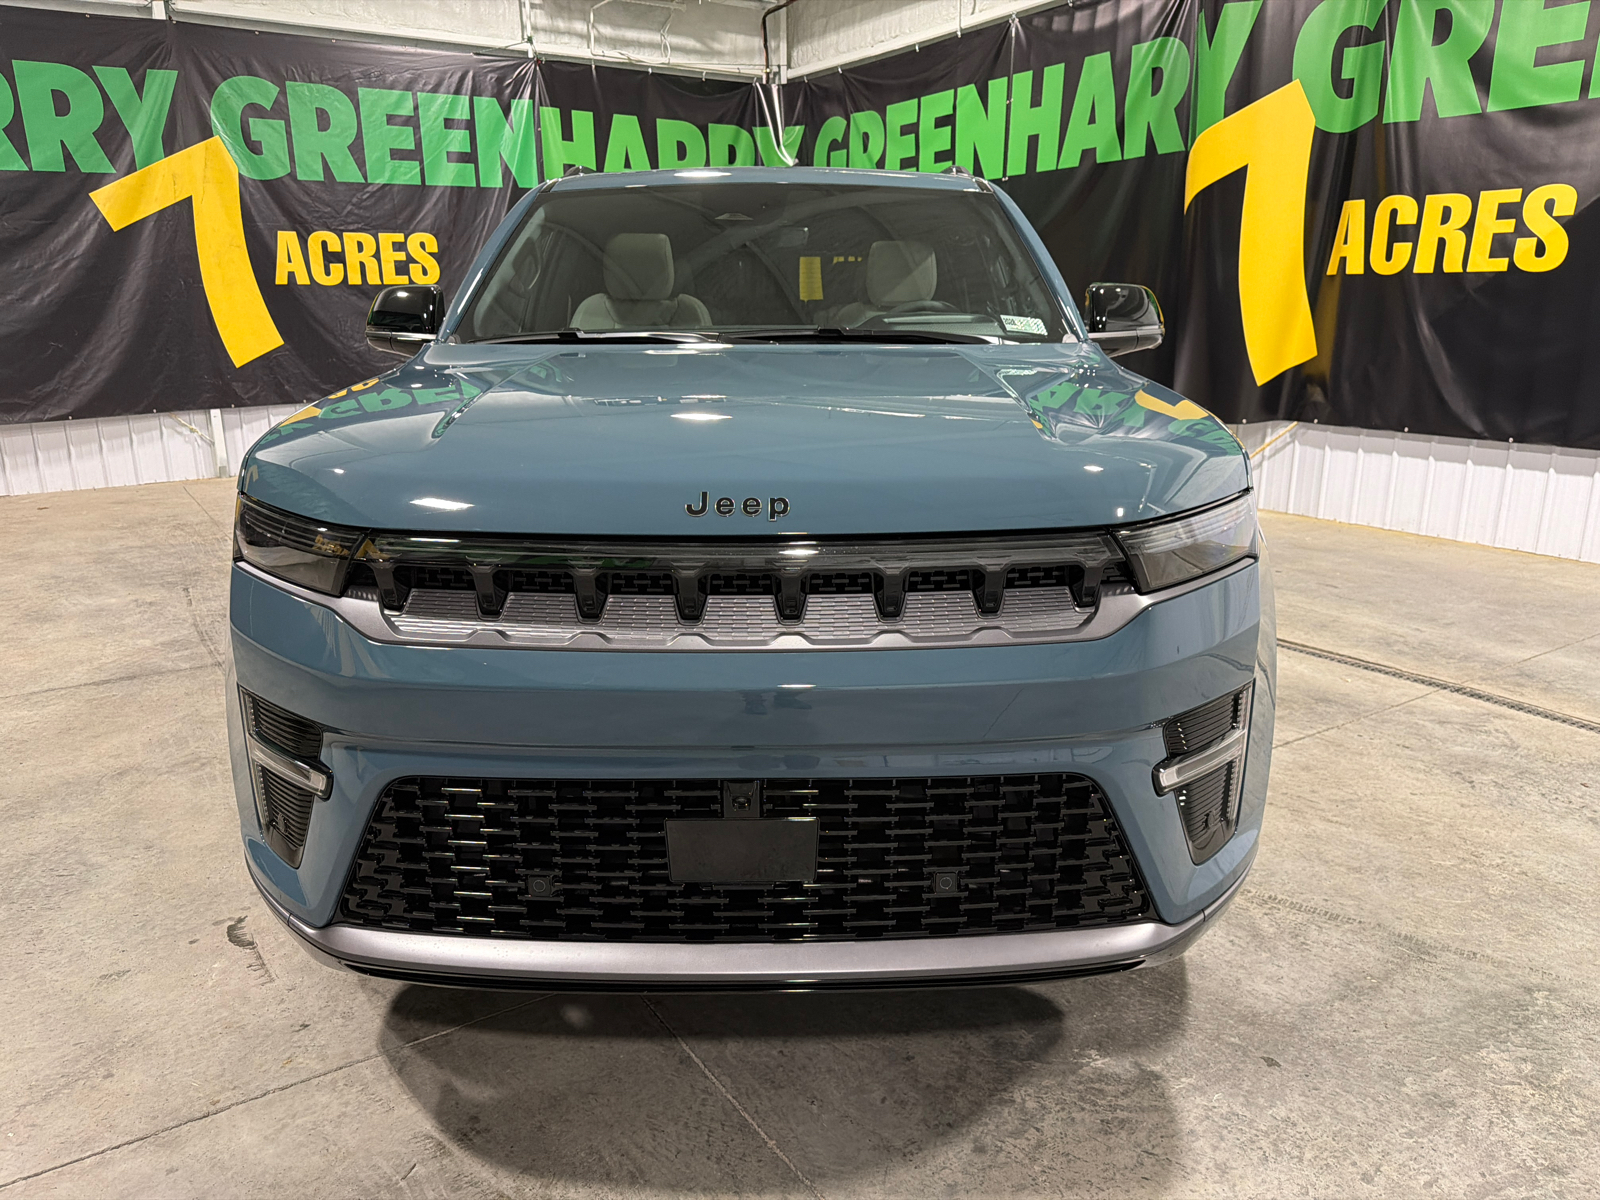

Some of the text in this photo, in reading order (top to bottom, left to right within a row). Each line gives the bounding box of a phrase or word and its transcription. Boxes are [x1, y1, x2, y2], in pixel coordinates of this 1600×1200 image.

[0, 59, 540, 190] RY GREEN
[813, 76, 1009, 182] GREEN
[1292, 0, 1600, 134] GRE
[89, 135, 441, 369] 7 ACRES
[1184, 78, 1578, 387] 7 ACRES
[684, 491, 790, 521] Jeep
